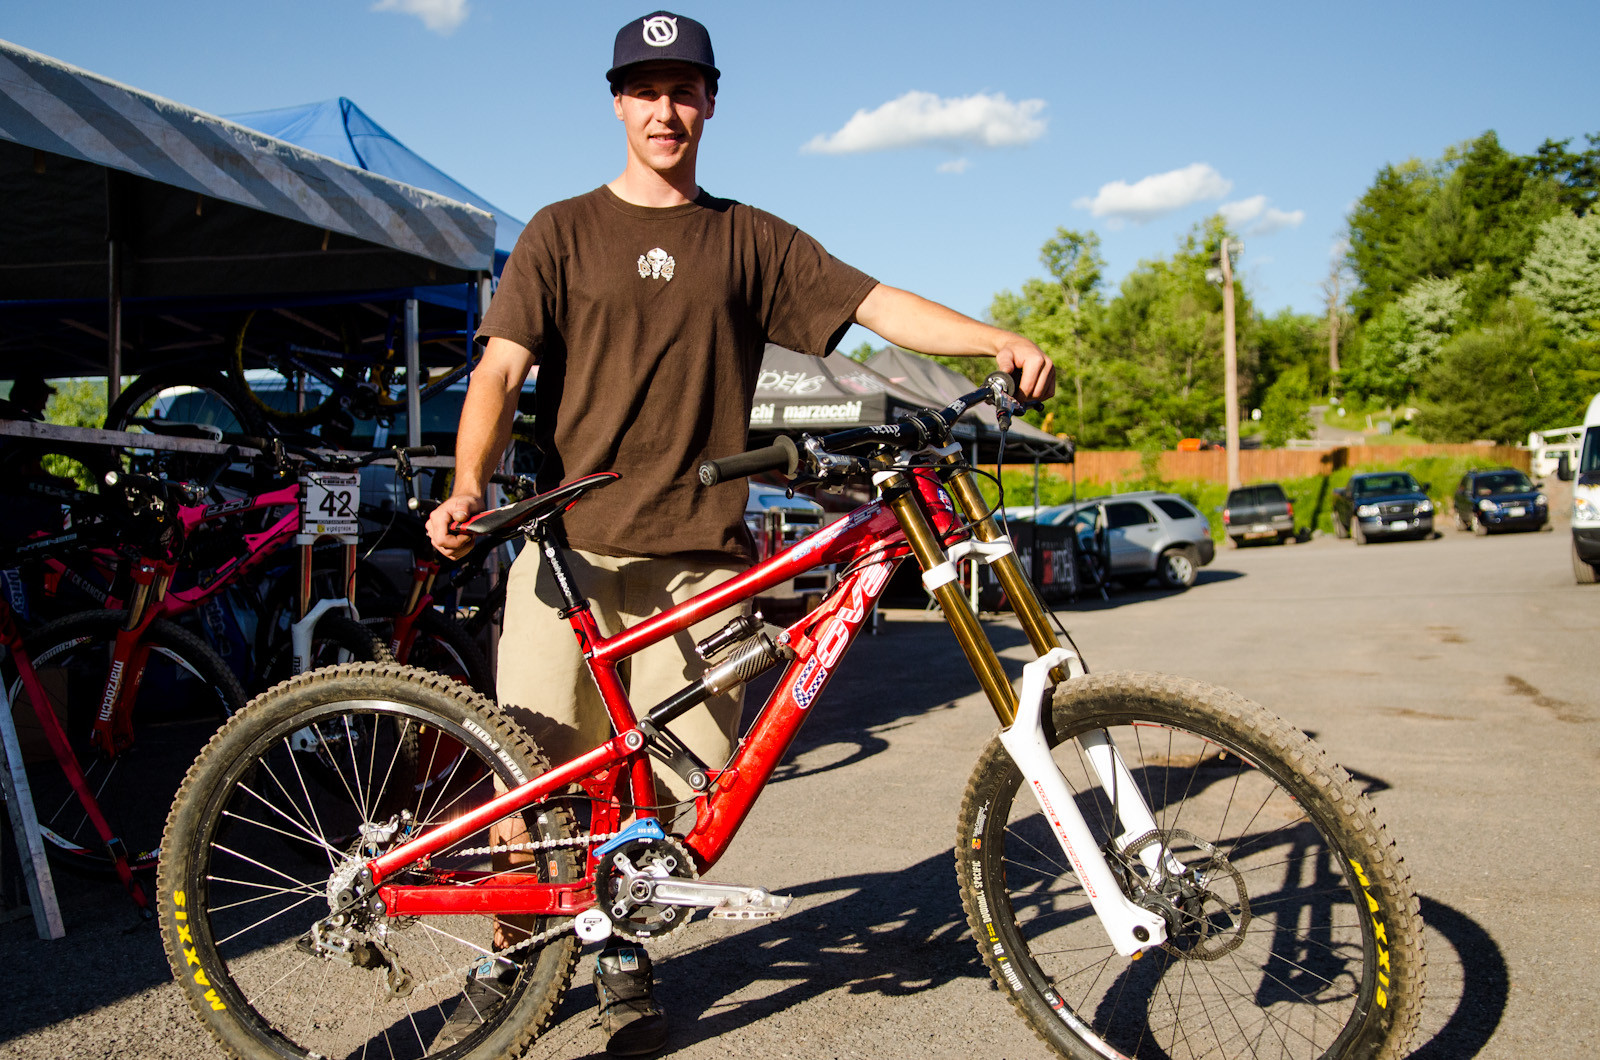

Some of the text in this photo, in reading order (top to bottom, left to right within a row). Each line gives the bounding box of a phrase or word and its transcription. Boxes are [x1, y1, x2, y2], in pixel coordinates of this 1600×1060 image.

[783, 401, 862, 419] marzocchi
[319, 490, 352, 517] 42
[792, 540, 894, 709] COVE
[98, 659, 125, 721] marzocchi
[173, 890, 227, 1011] MAXXIS
[1349, 858, 1391, 1010] MAXXIS
